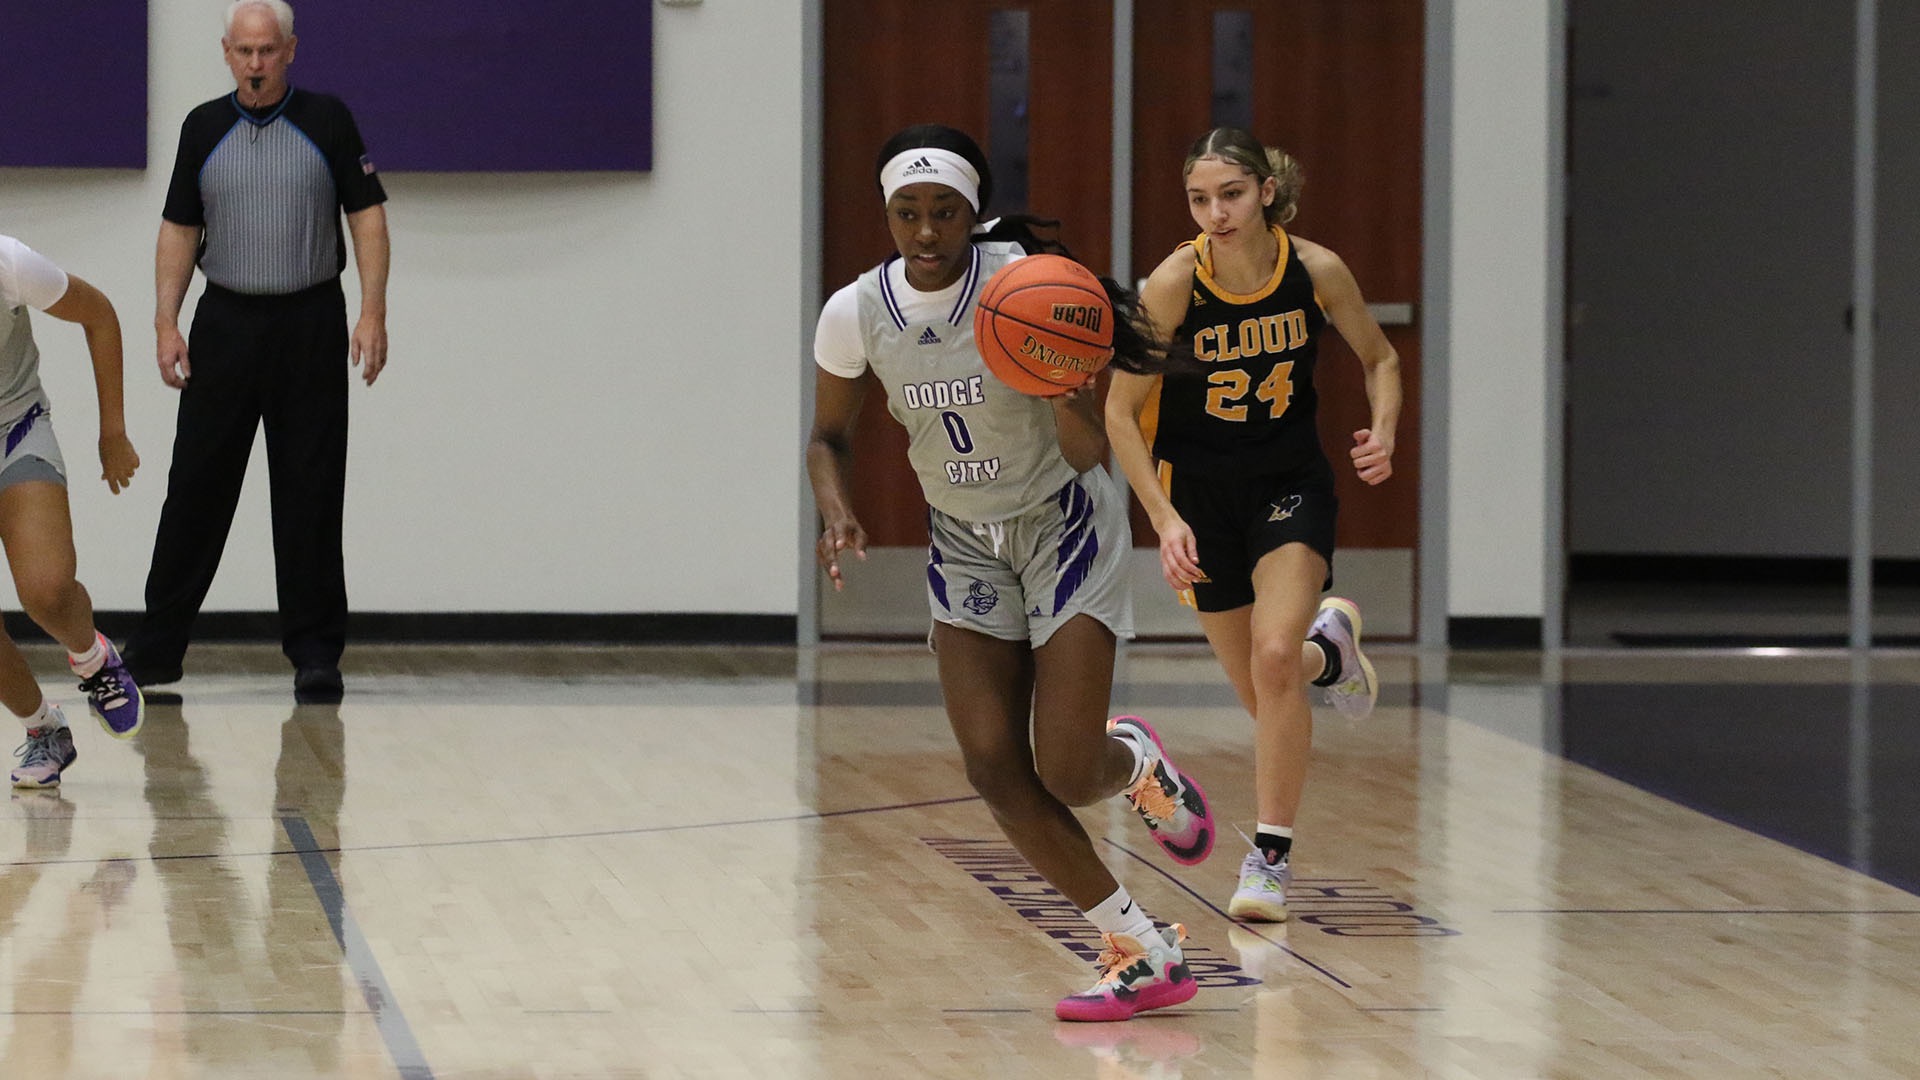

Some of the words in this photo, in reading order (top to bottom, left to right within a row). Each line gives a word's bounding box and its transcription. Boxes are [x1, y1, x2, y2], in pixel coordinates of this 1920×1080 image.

[902, 166, 939, 177] adidas
[1052, 305, 1103, 333] NJCAA
[917, 336, 942, 346] adidas
[1193, 308, 1309, 362] CLOUD
[903, 375, 985, 410] DODGE
[1205, 360, 1295, 422] 24
[941, 410, 975, 456] 0
[944, 456, 1000, 484] CITY
